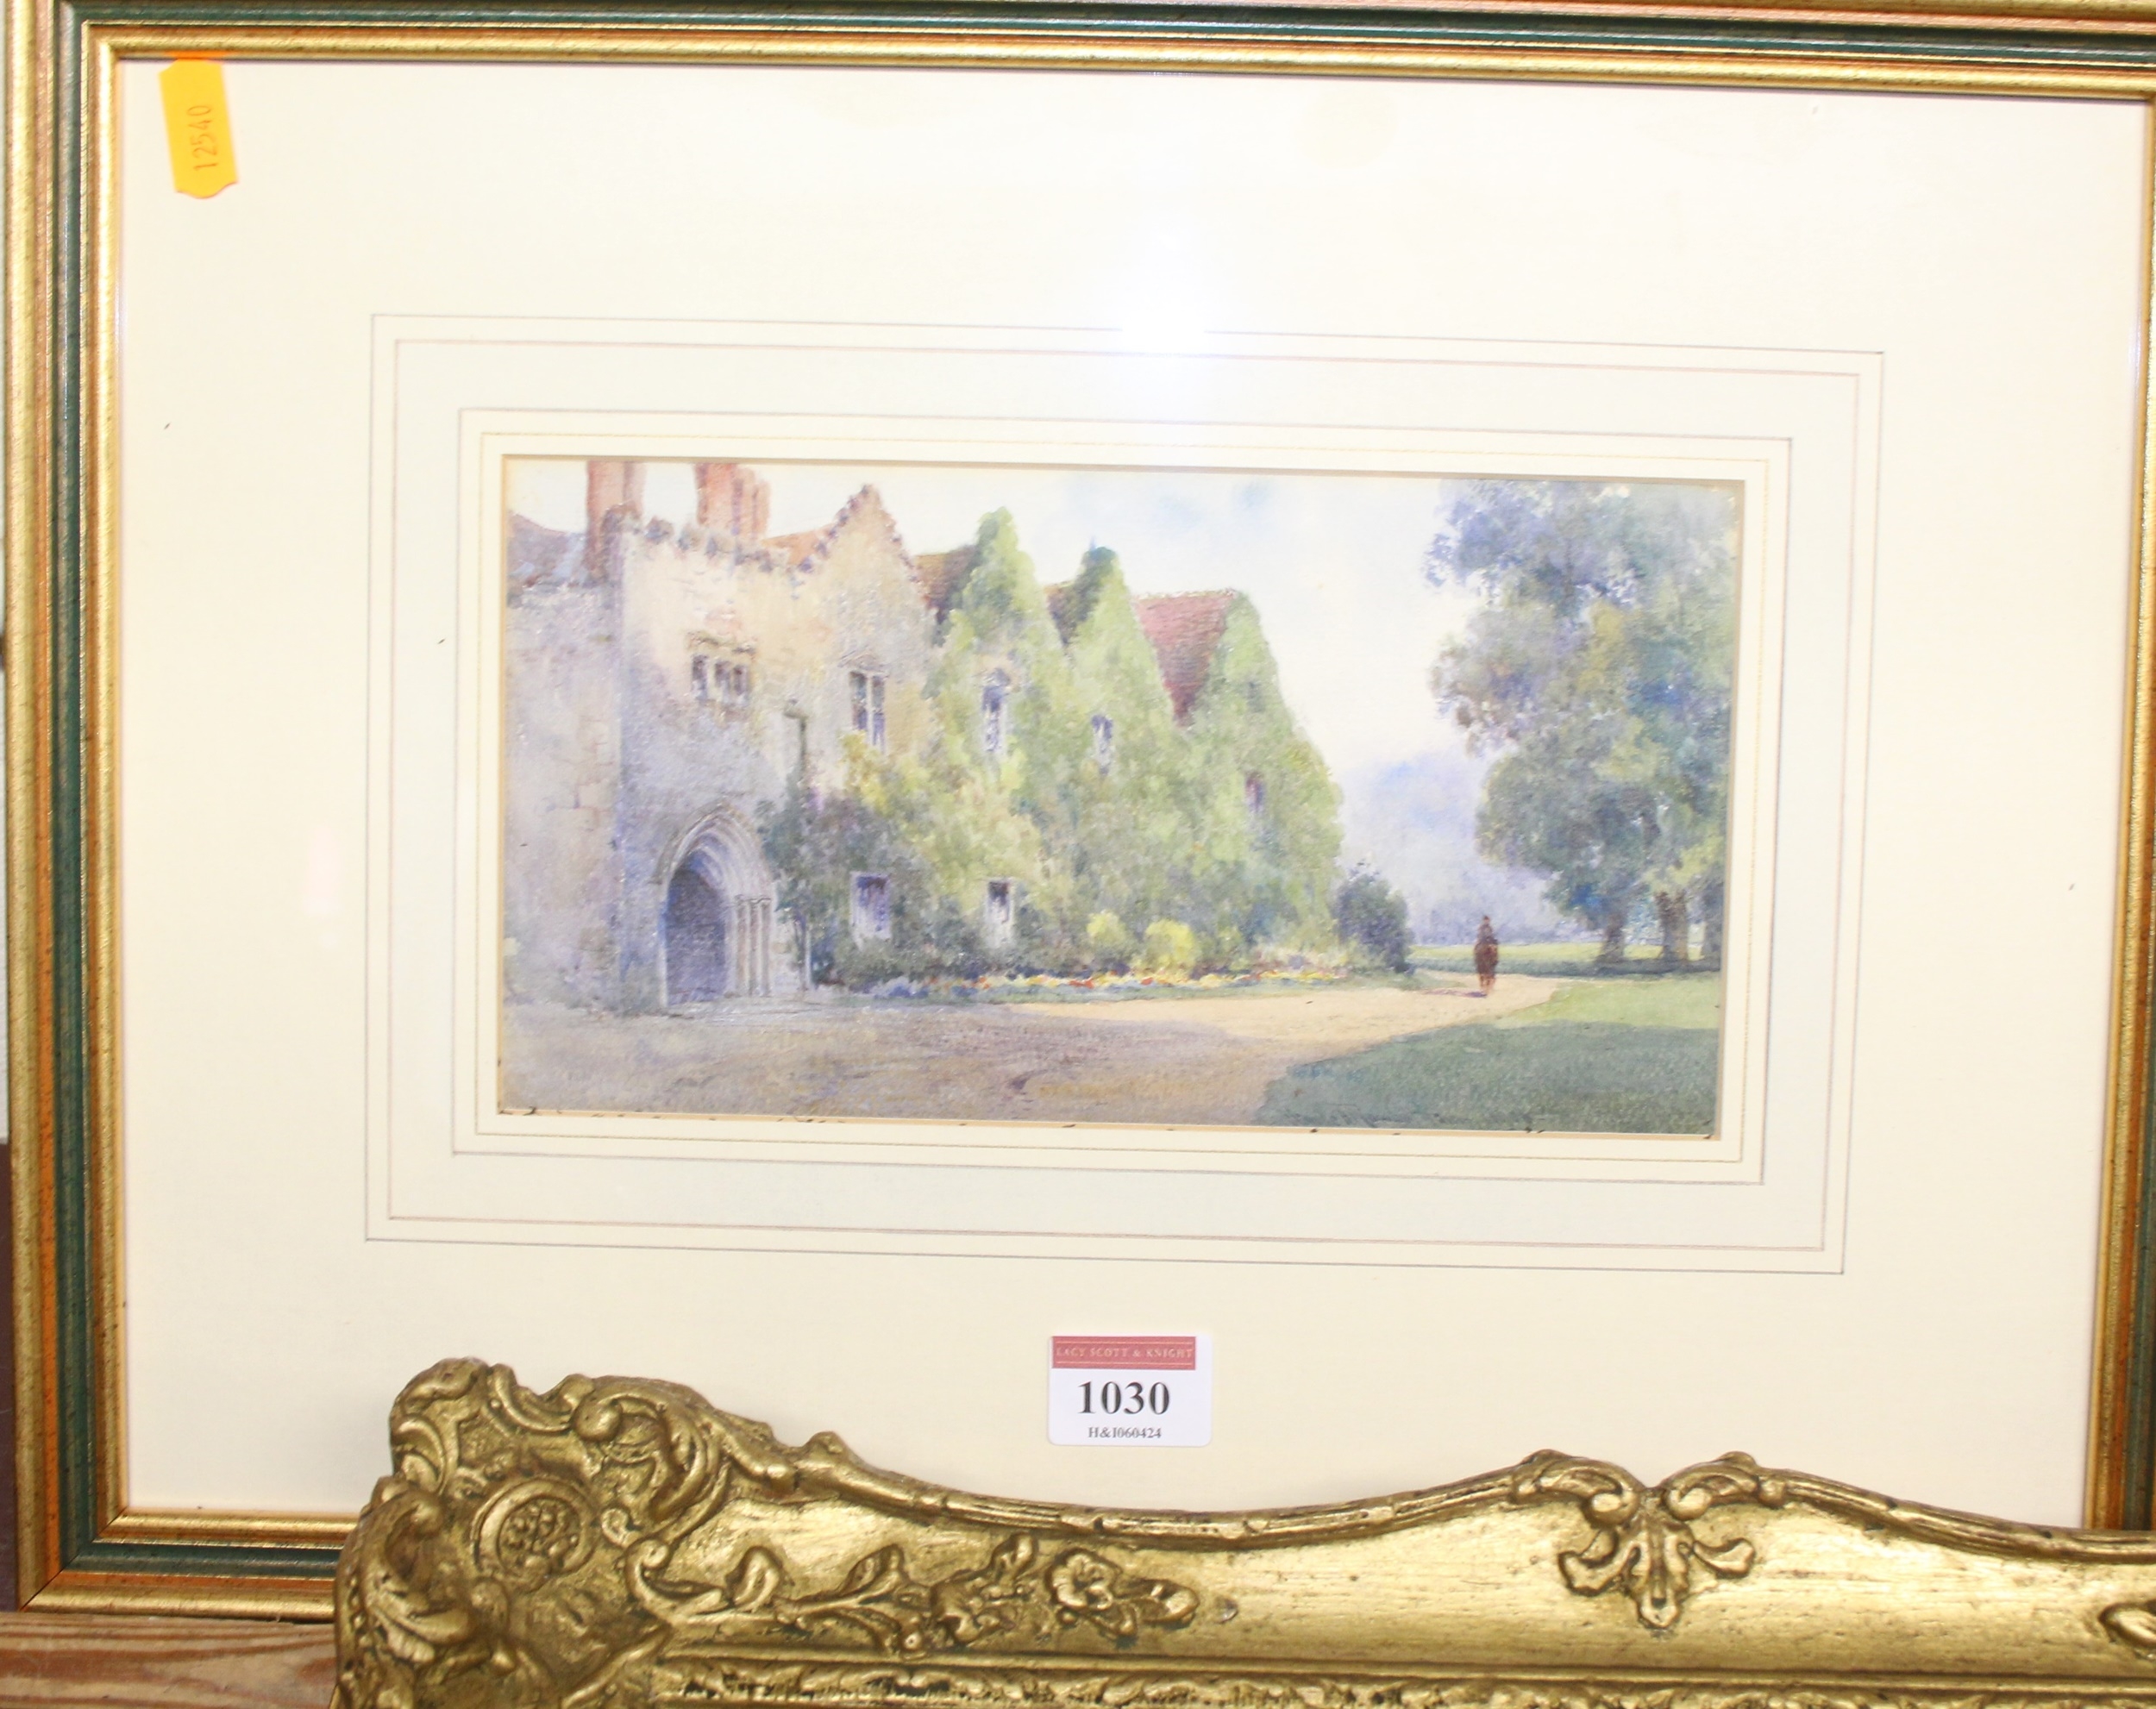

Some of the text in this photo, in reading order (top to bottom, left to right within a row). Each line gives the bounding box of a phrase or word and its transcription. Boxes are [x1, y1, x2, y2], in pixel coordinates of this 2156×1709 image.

[1056, 1347, 1193, 1358] LACY SCOTT & KNIGHT
[1078, 1380, 1170, 1415] 1030
[1088, 1427, 1162, 1438] H&I060424
